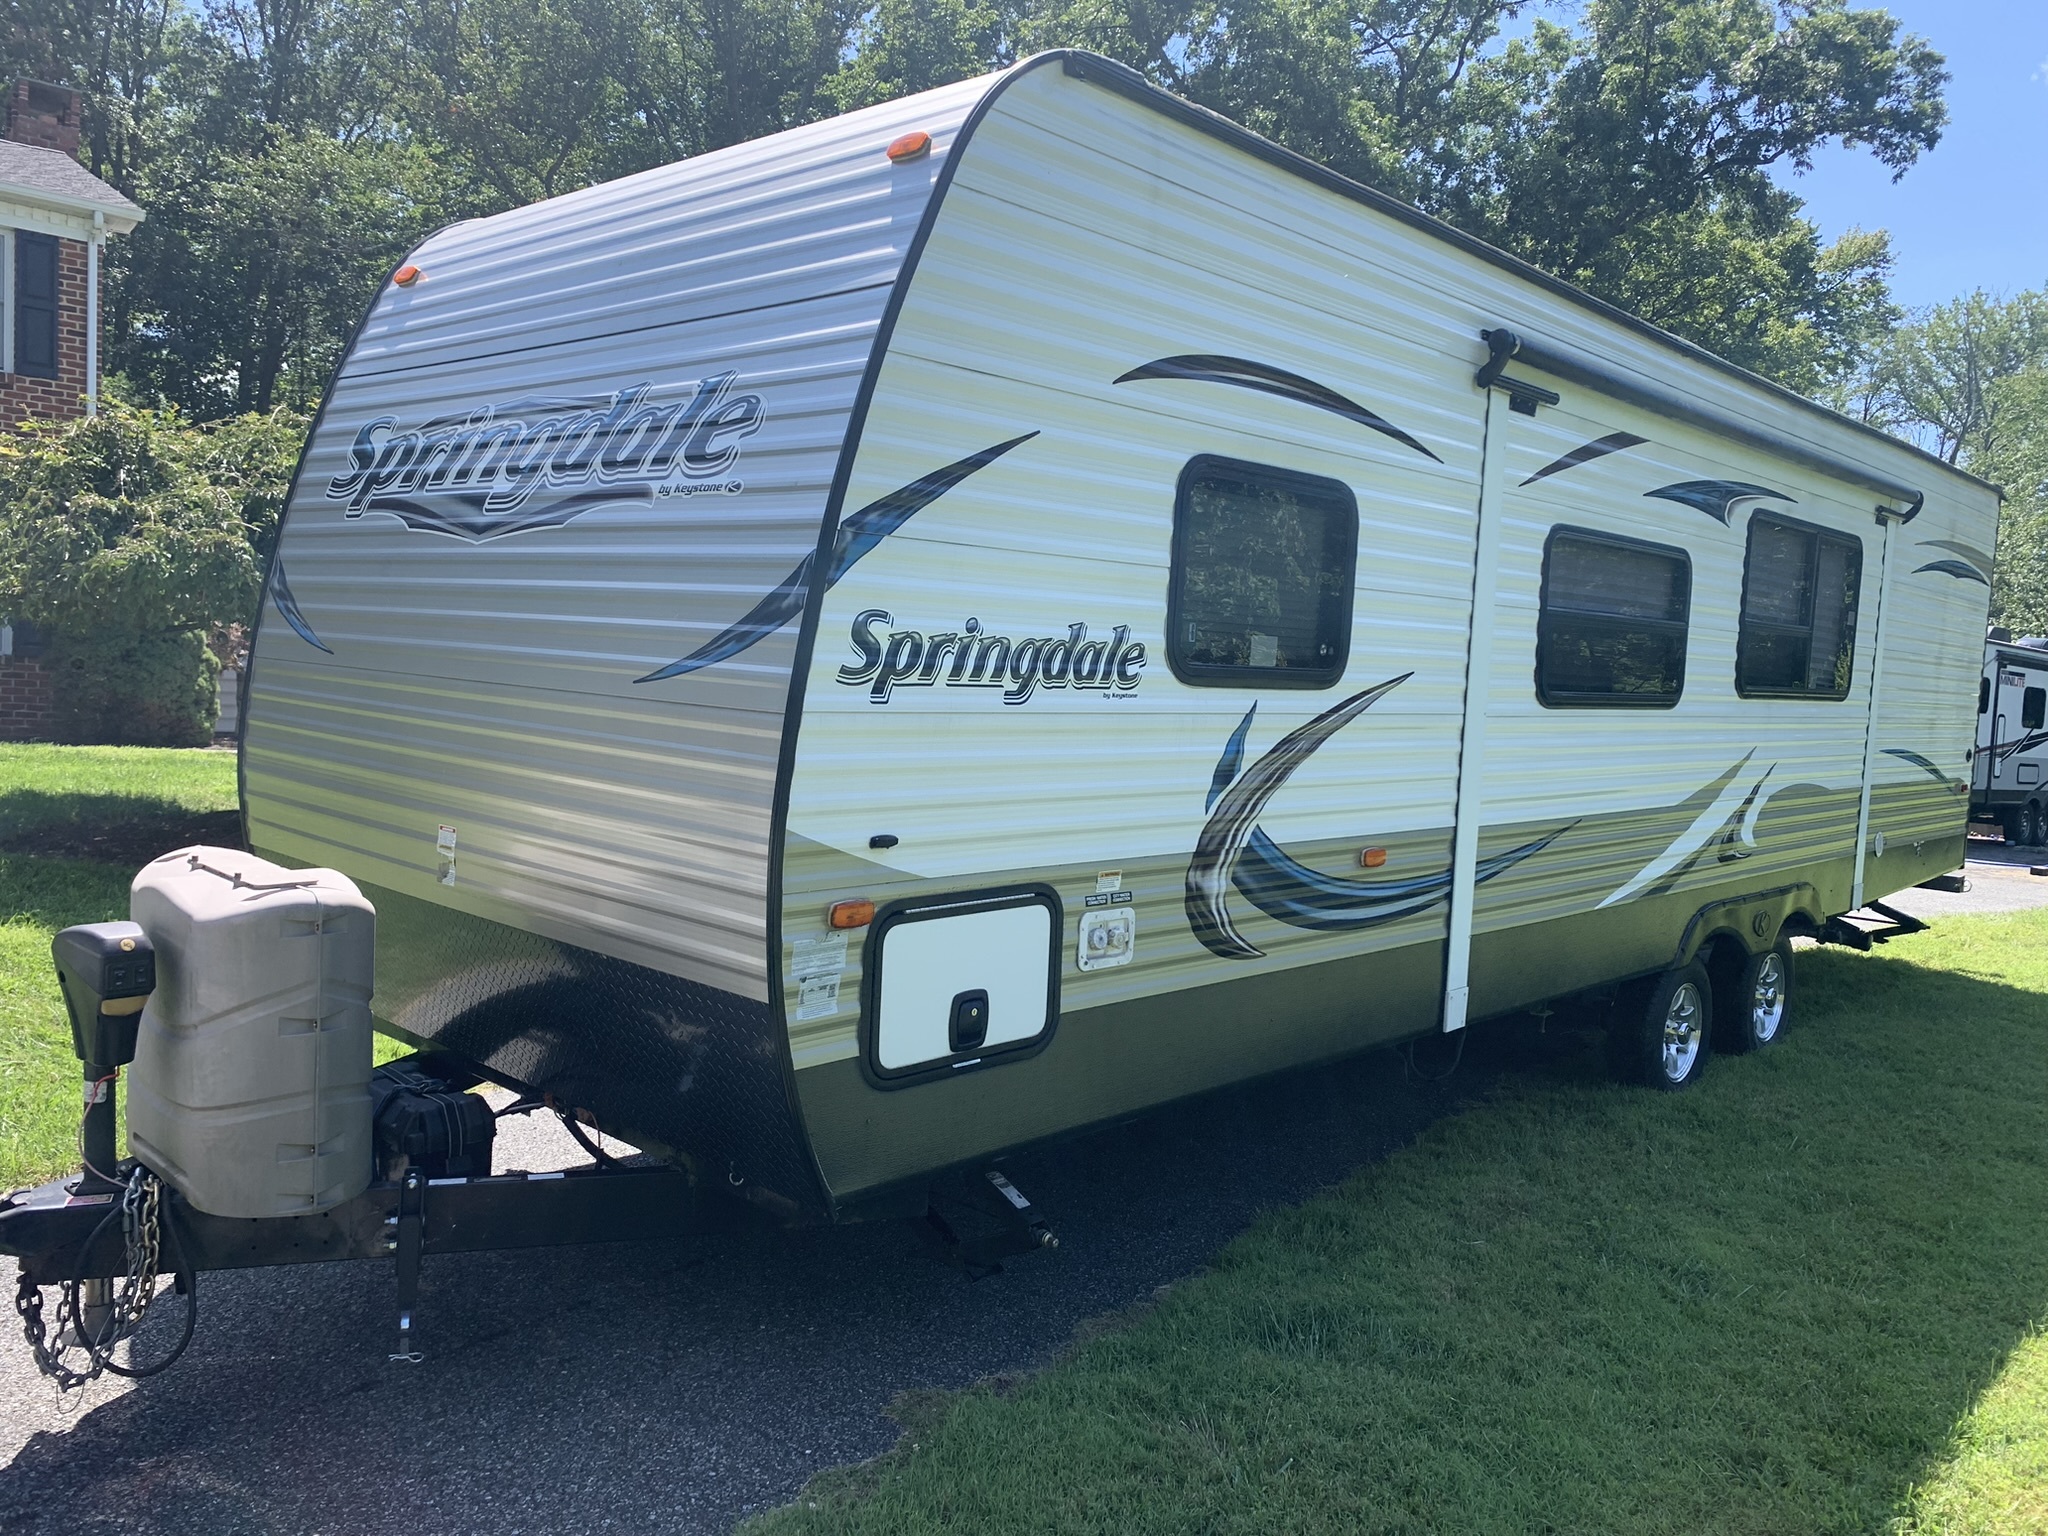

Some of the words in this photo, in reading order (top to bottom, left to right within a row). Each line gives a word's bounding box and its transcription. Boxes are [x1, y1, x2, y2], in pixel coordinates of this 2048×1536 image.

[326, 368, 766, 520] Springdale
[657, 484, 672, 497] by
[673, 482, 724, 496] Keystone
[835, 607, 1148, 705] Springdale
[1102, 692, 1112, 700] by
[1112, 692, 1138, 700] Keystone
